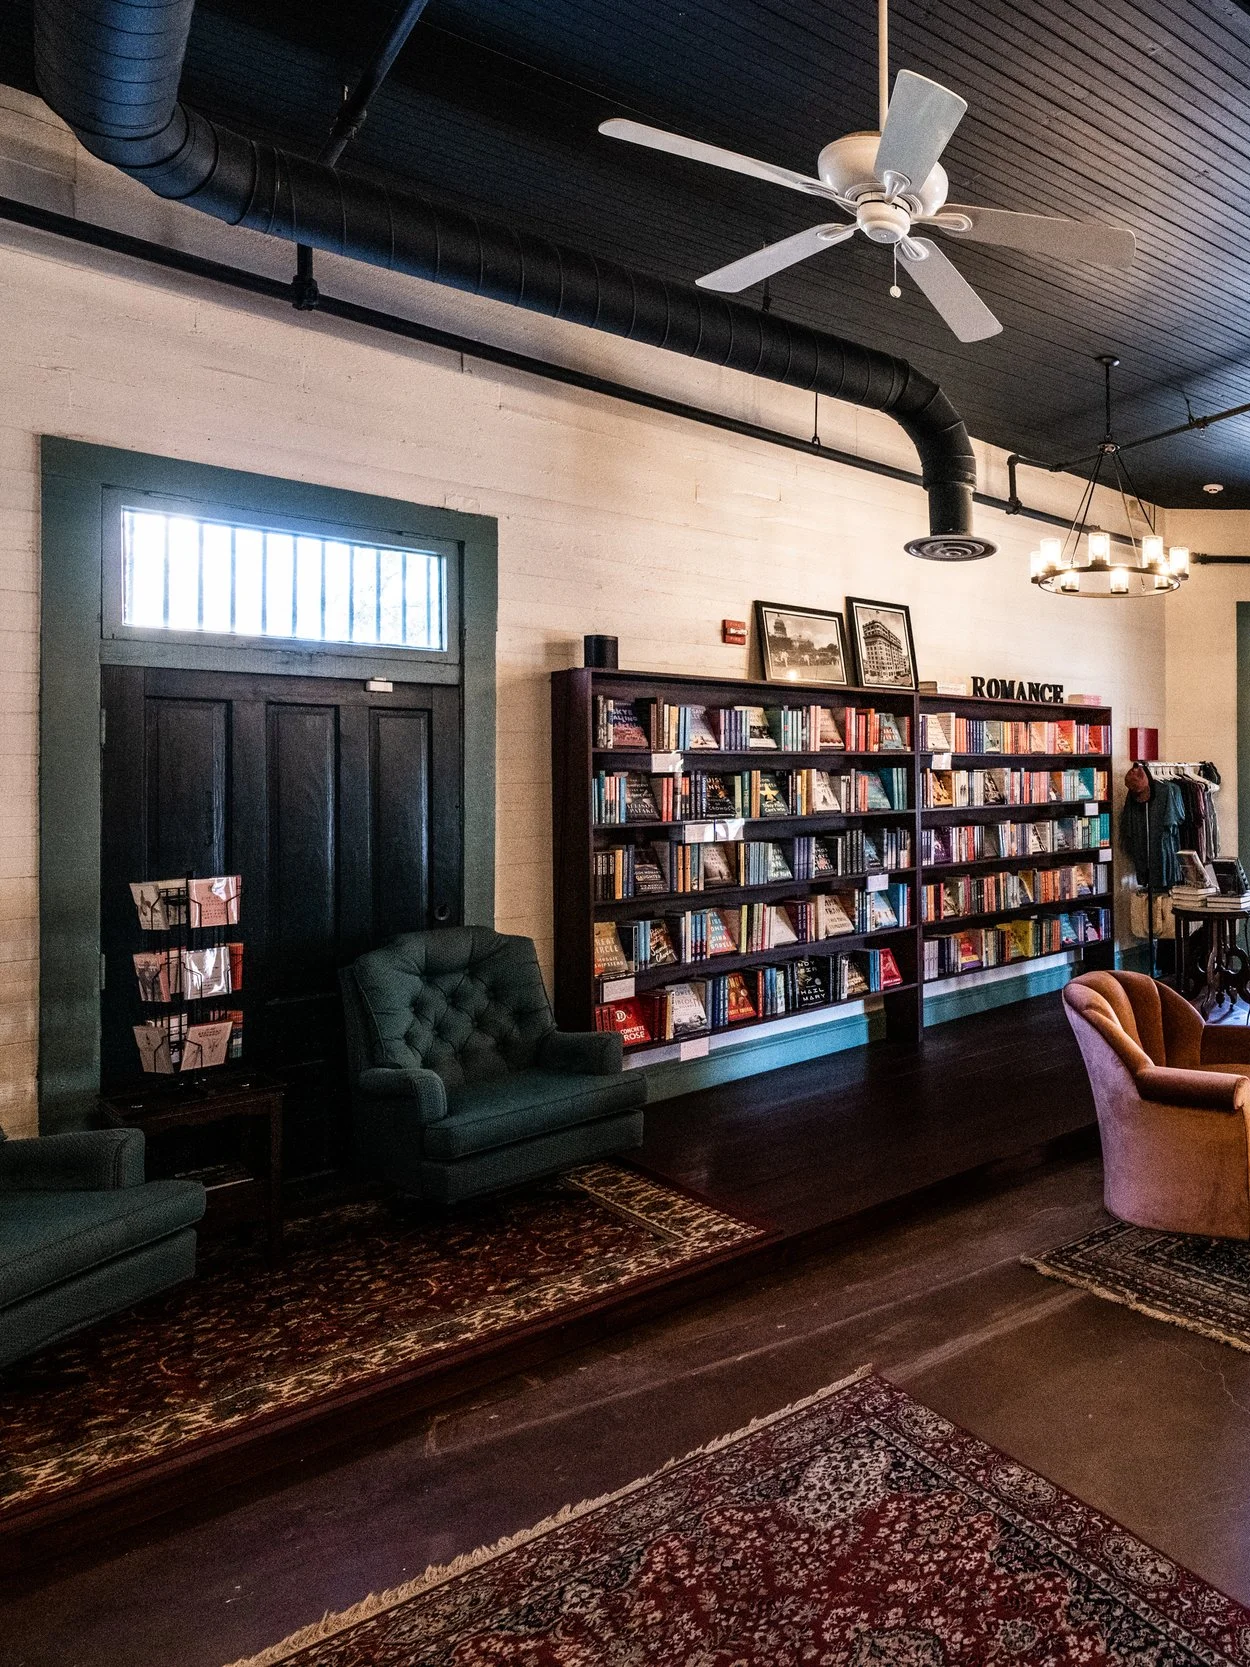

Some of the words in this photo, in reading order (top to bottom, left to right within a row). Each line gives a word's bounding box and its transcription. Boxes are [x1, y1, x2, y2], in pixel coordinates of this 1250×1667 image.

[971, 676, 1064, 704] ROMANCE
[800, 987, 825, 995] HAIL
[802, 993, 827, 1001] MARY
[620, 1025, 645, 1035] CONCRETE
[623, 1032, 646, 1041] ROSE
